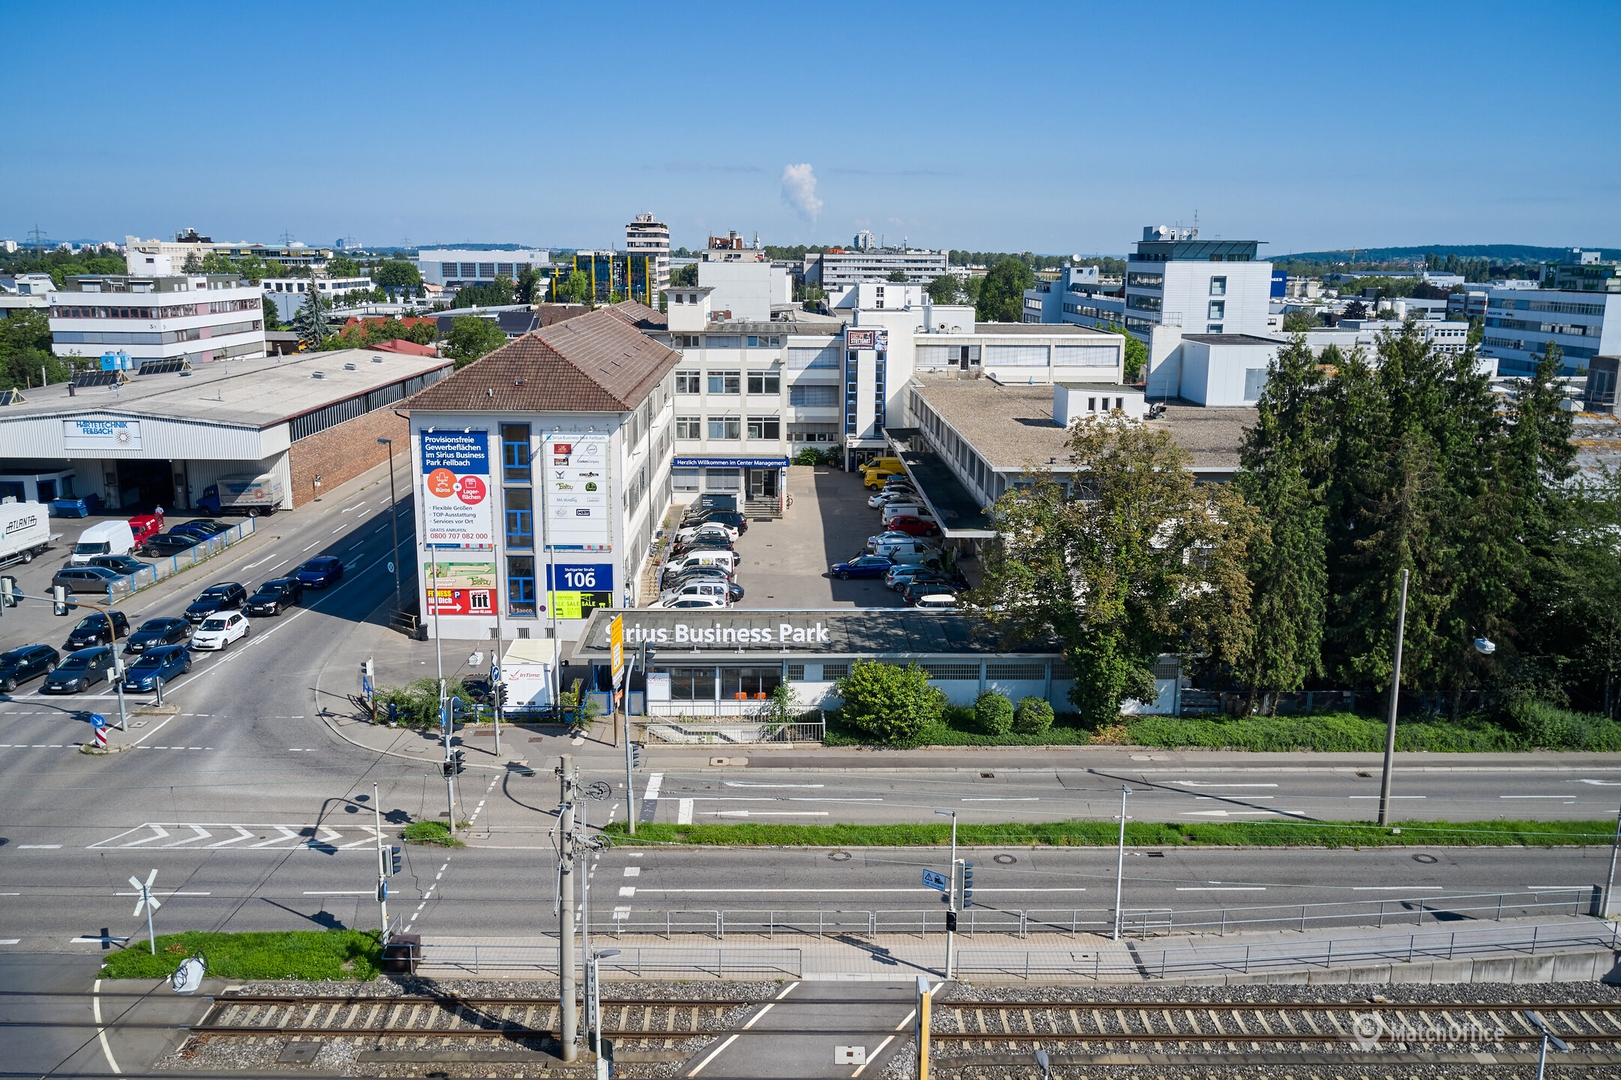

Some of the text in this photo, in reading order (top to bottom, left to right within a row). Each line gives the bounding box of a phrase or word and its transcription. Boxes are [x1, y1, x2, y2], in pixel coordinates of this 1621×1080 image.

[424, 436, 475, 444] Provisionsfreie
[6, 514, 38, 532] ATLANTA
[564, 572, 596, 588] 106
[427, 589, 452, 597] FINESS
[472, 594, 489, 608] fit
[674, 623, 772, 643] Business
[779, 623, 831, 643] Park
